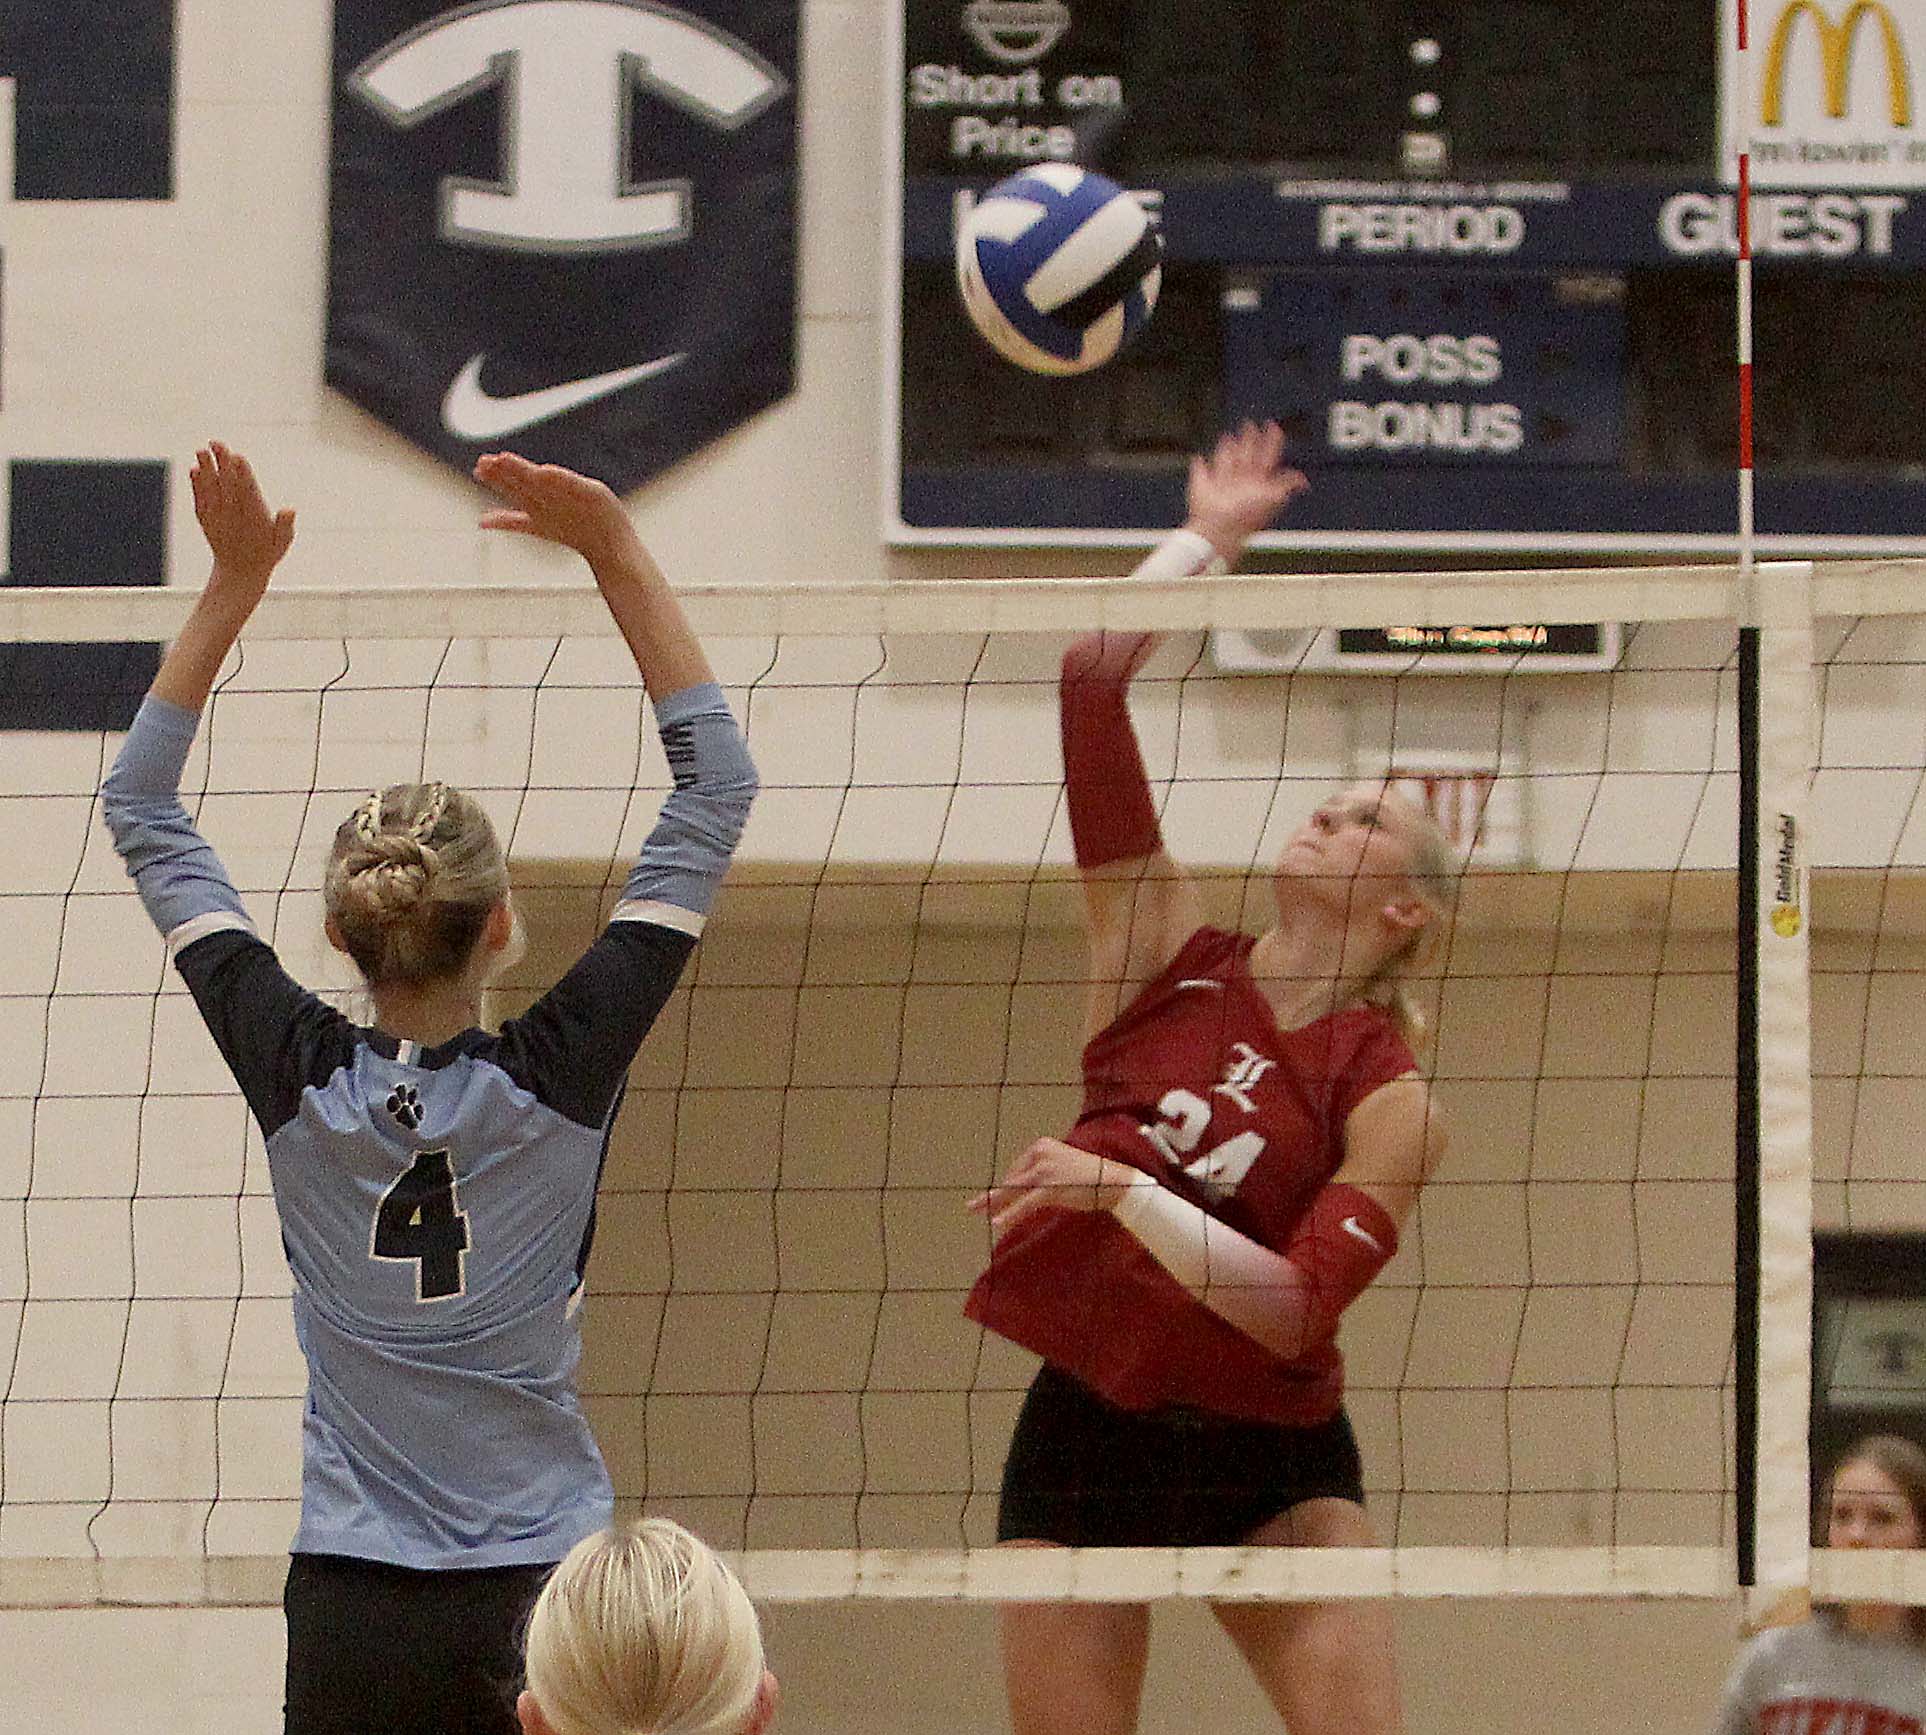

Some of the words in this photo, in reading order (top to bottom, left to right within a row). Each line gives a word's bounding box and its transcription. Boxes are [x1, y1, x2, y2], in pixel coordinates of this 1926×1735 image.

[909, 63, 1043, 105] Short
[1058, 74, 1122, 106] on
[348, 0, 788, 250] T
[952, 115, 1076, 157] Price
[1318, 204, 1526, 253] PERIOD
[1659, 192, 1906, 256] GUEST
[1341, 333, 1501, 384] POSS
[1328, 401, 1525, 451] BONUS
[1137, 1088, 1267, 1198] 24
[369, 1147, 472, 1303] 4
